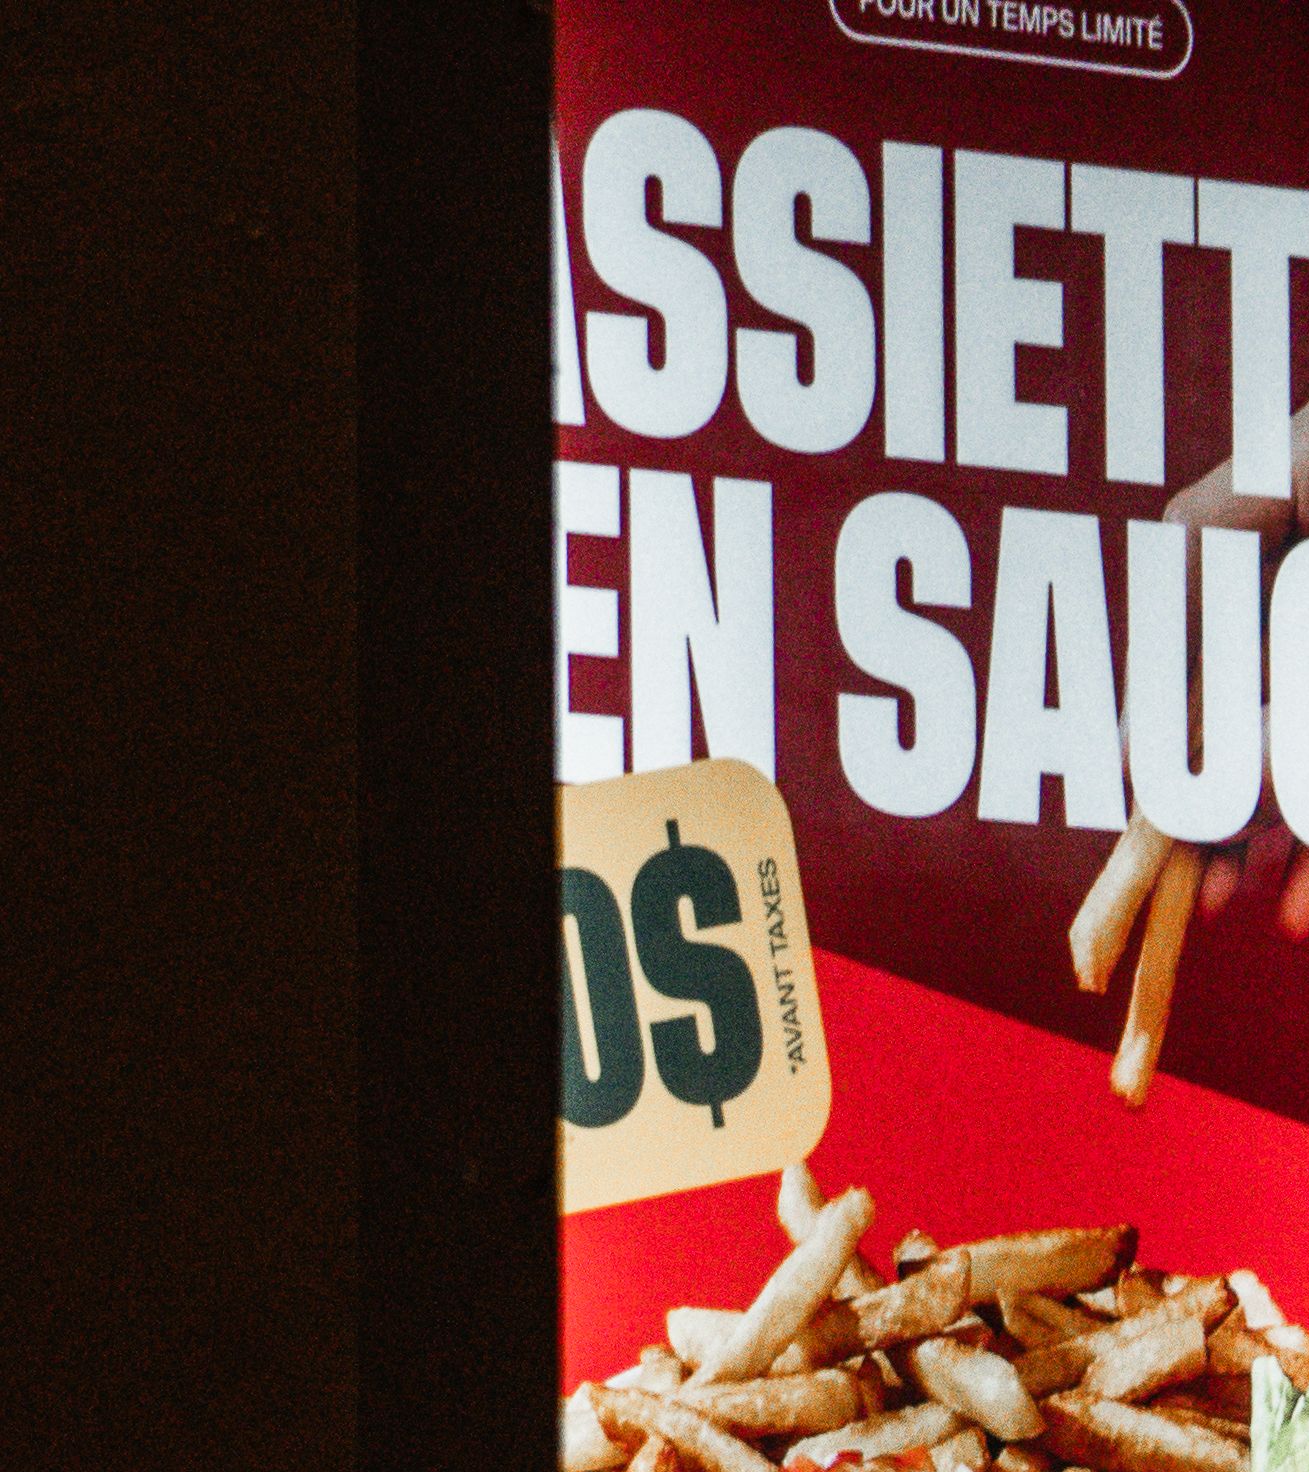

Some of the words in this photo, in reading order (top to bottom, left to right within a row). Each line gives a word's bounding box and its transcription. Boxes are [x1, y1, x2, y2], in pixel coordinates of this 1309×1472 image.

[941, 0, 981, 28] UN
[989, 1, 1075, 39] TEMPS
[1081, 12, 1164, 51] LIMITÉ
[555, 460, 777, 787] EN
[757, 857, 788, 959] TAXES
